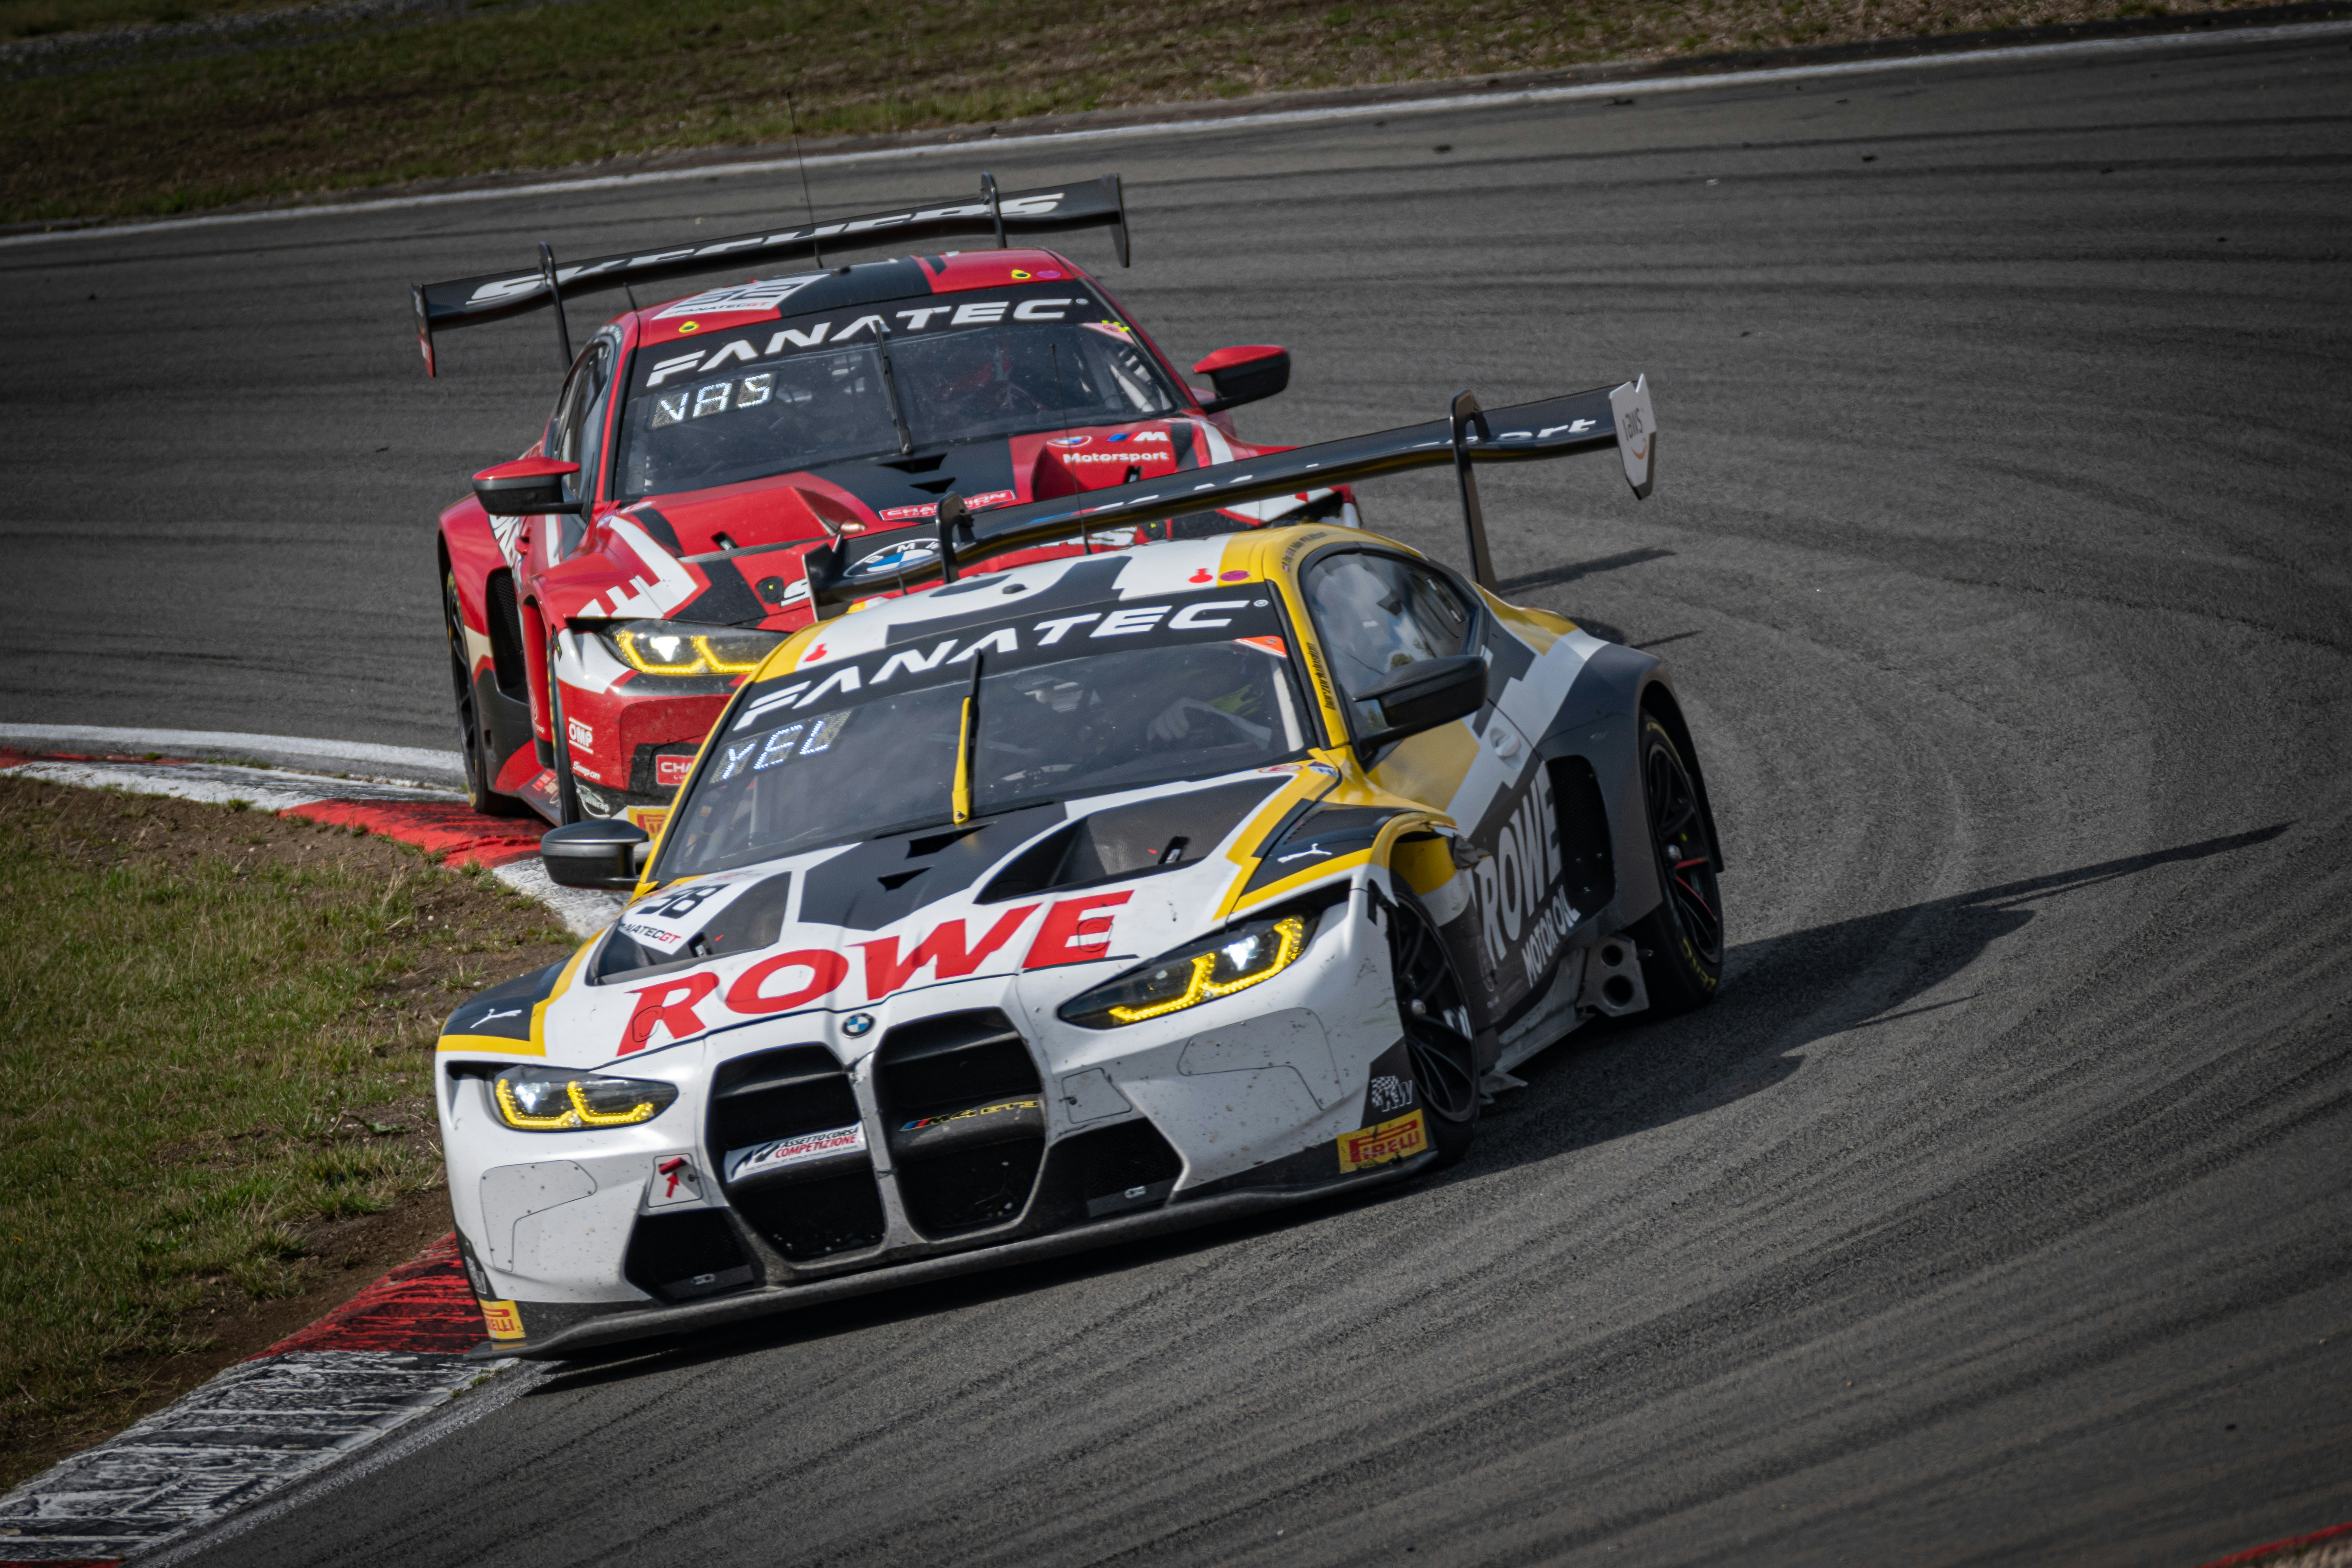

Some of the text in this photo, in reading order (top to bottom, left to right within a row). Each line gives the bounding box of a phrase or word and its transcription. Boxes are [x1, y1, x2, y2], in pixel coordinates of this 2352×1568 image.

[670, 283, 804, 309] 32
[646, 298, 1073, 387] FANATEC
[1063, 451, 1170, 464] Motorsport
[887, 492, 1006, 516] CHAION
[733, 599, 1250, 732] FANATEC
[568, 722, 593, 748] OMP
[722, 720, 830, 780] YEL
[573, 760, 601, 781] Snap-on
[1474, 760, 1563, 970] ROWE
[1521, 884, 1581, 989] MOTOR OIL
[616, 889, 1135, 1058] ROWE
[775, 1134, 857, 1158] COMPETIZIONE
[780, 1126, 859, 1149] ASSETTO CORSA
[1348, 1118, 1421, 1163] PIRELLI
